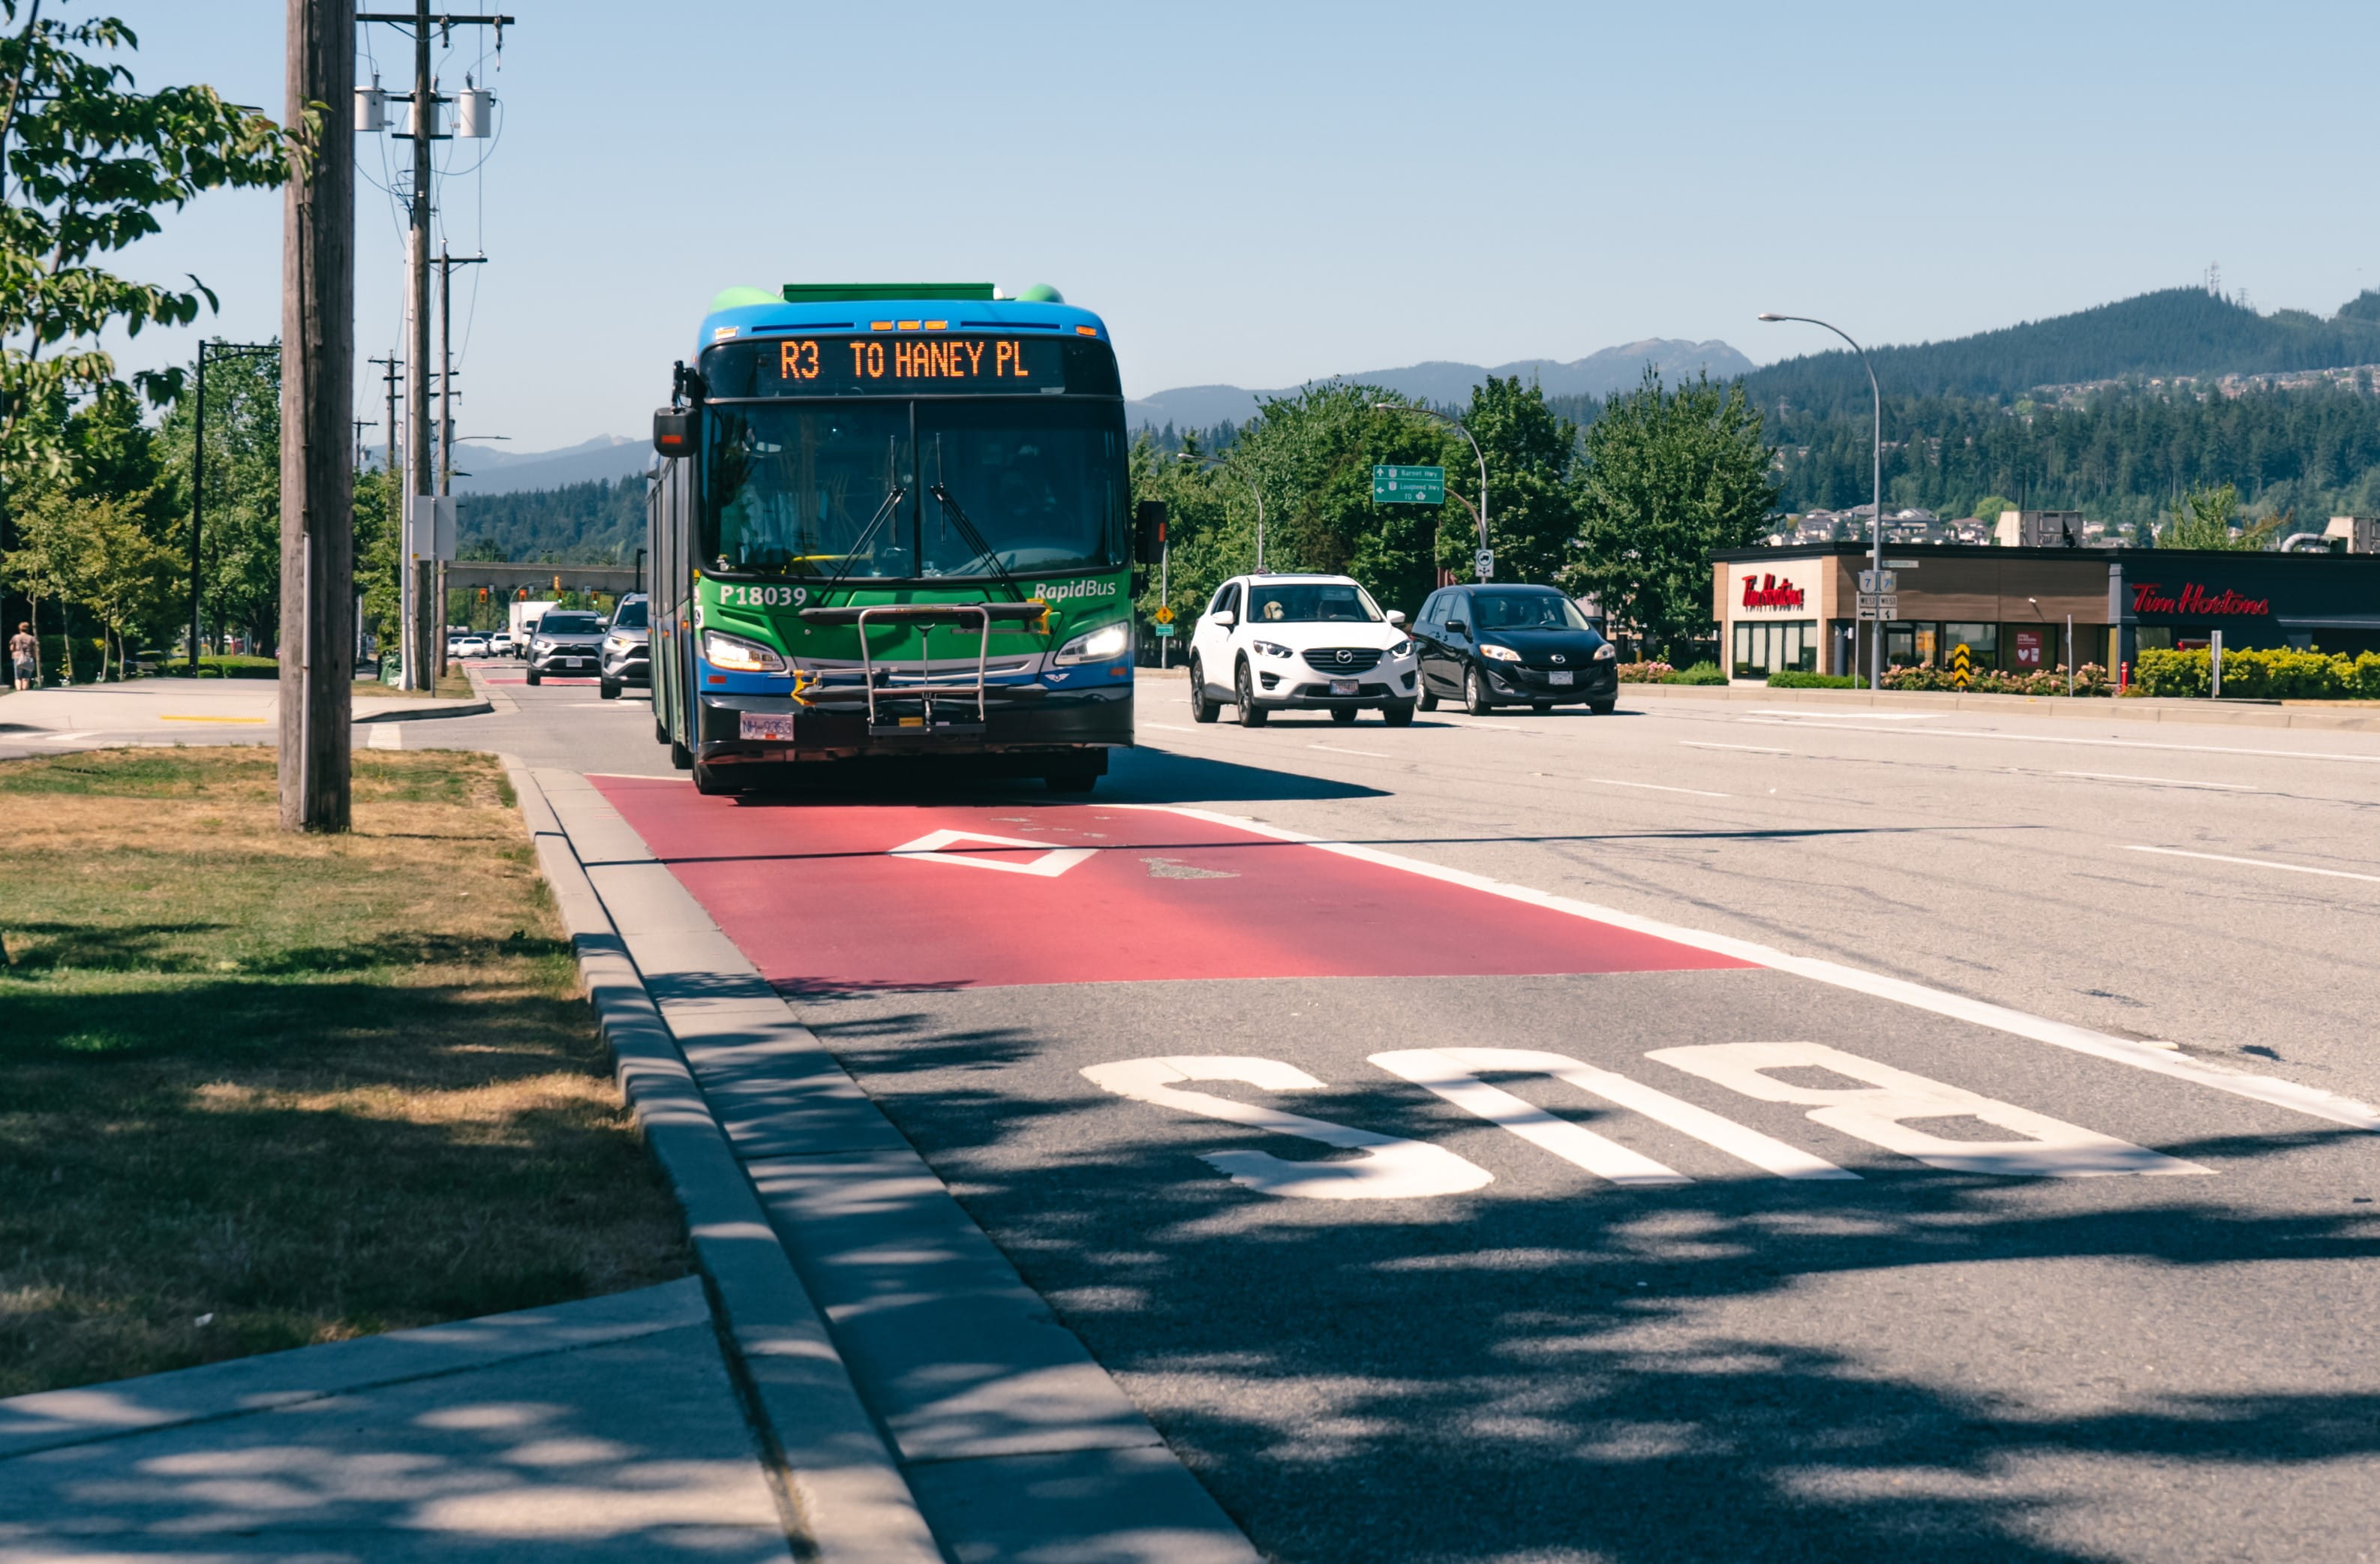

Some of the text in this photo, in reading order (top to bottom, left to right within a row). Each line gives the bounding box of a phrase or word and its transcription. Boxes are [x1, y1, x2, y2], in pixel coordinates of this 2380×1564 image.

[781, 341, 1029, 378] R3 TO HANEY PL
[720, 585, 807, 607] P18039
[1035, 580, 1116, 603] RapidBus
[1865, 578, 1871, 587] 7
[2131, 582, 2269, 615] Tim Hortons
[1079, 1040, 2219, 1200] BUS
